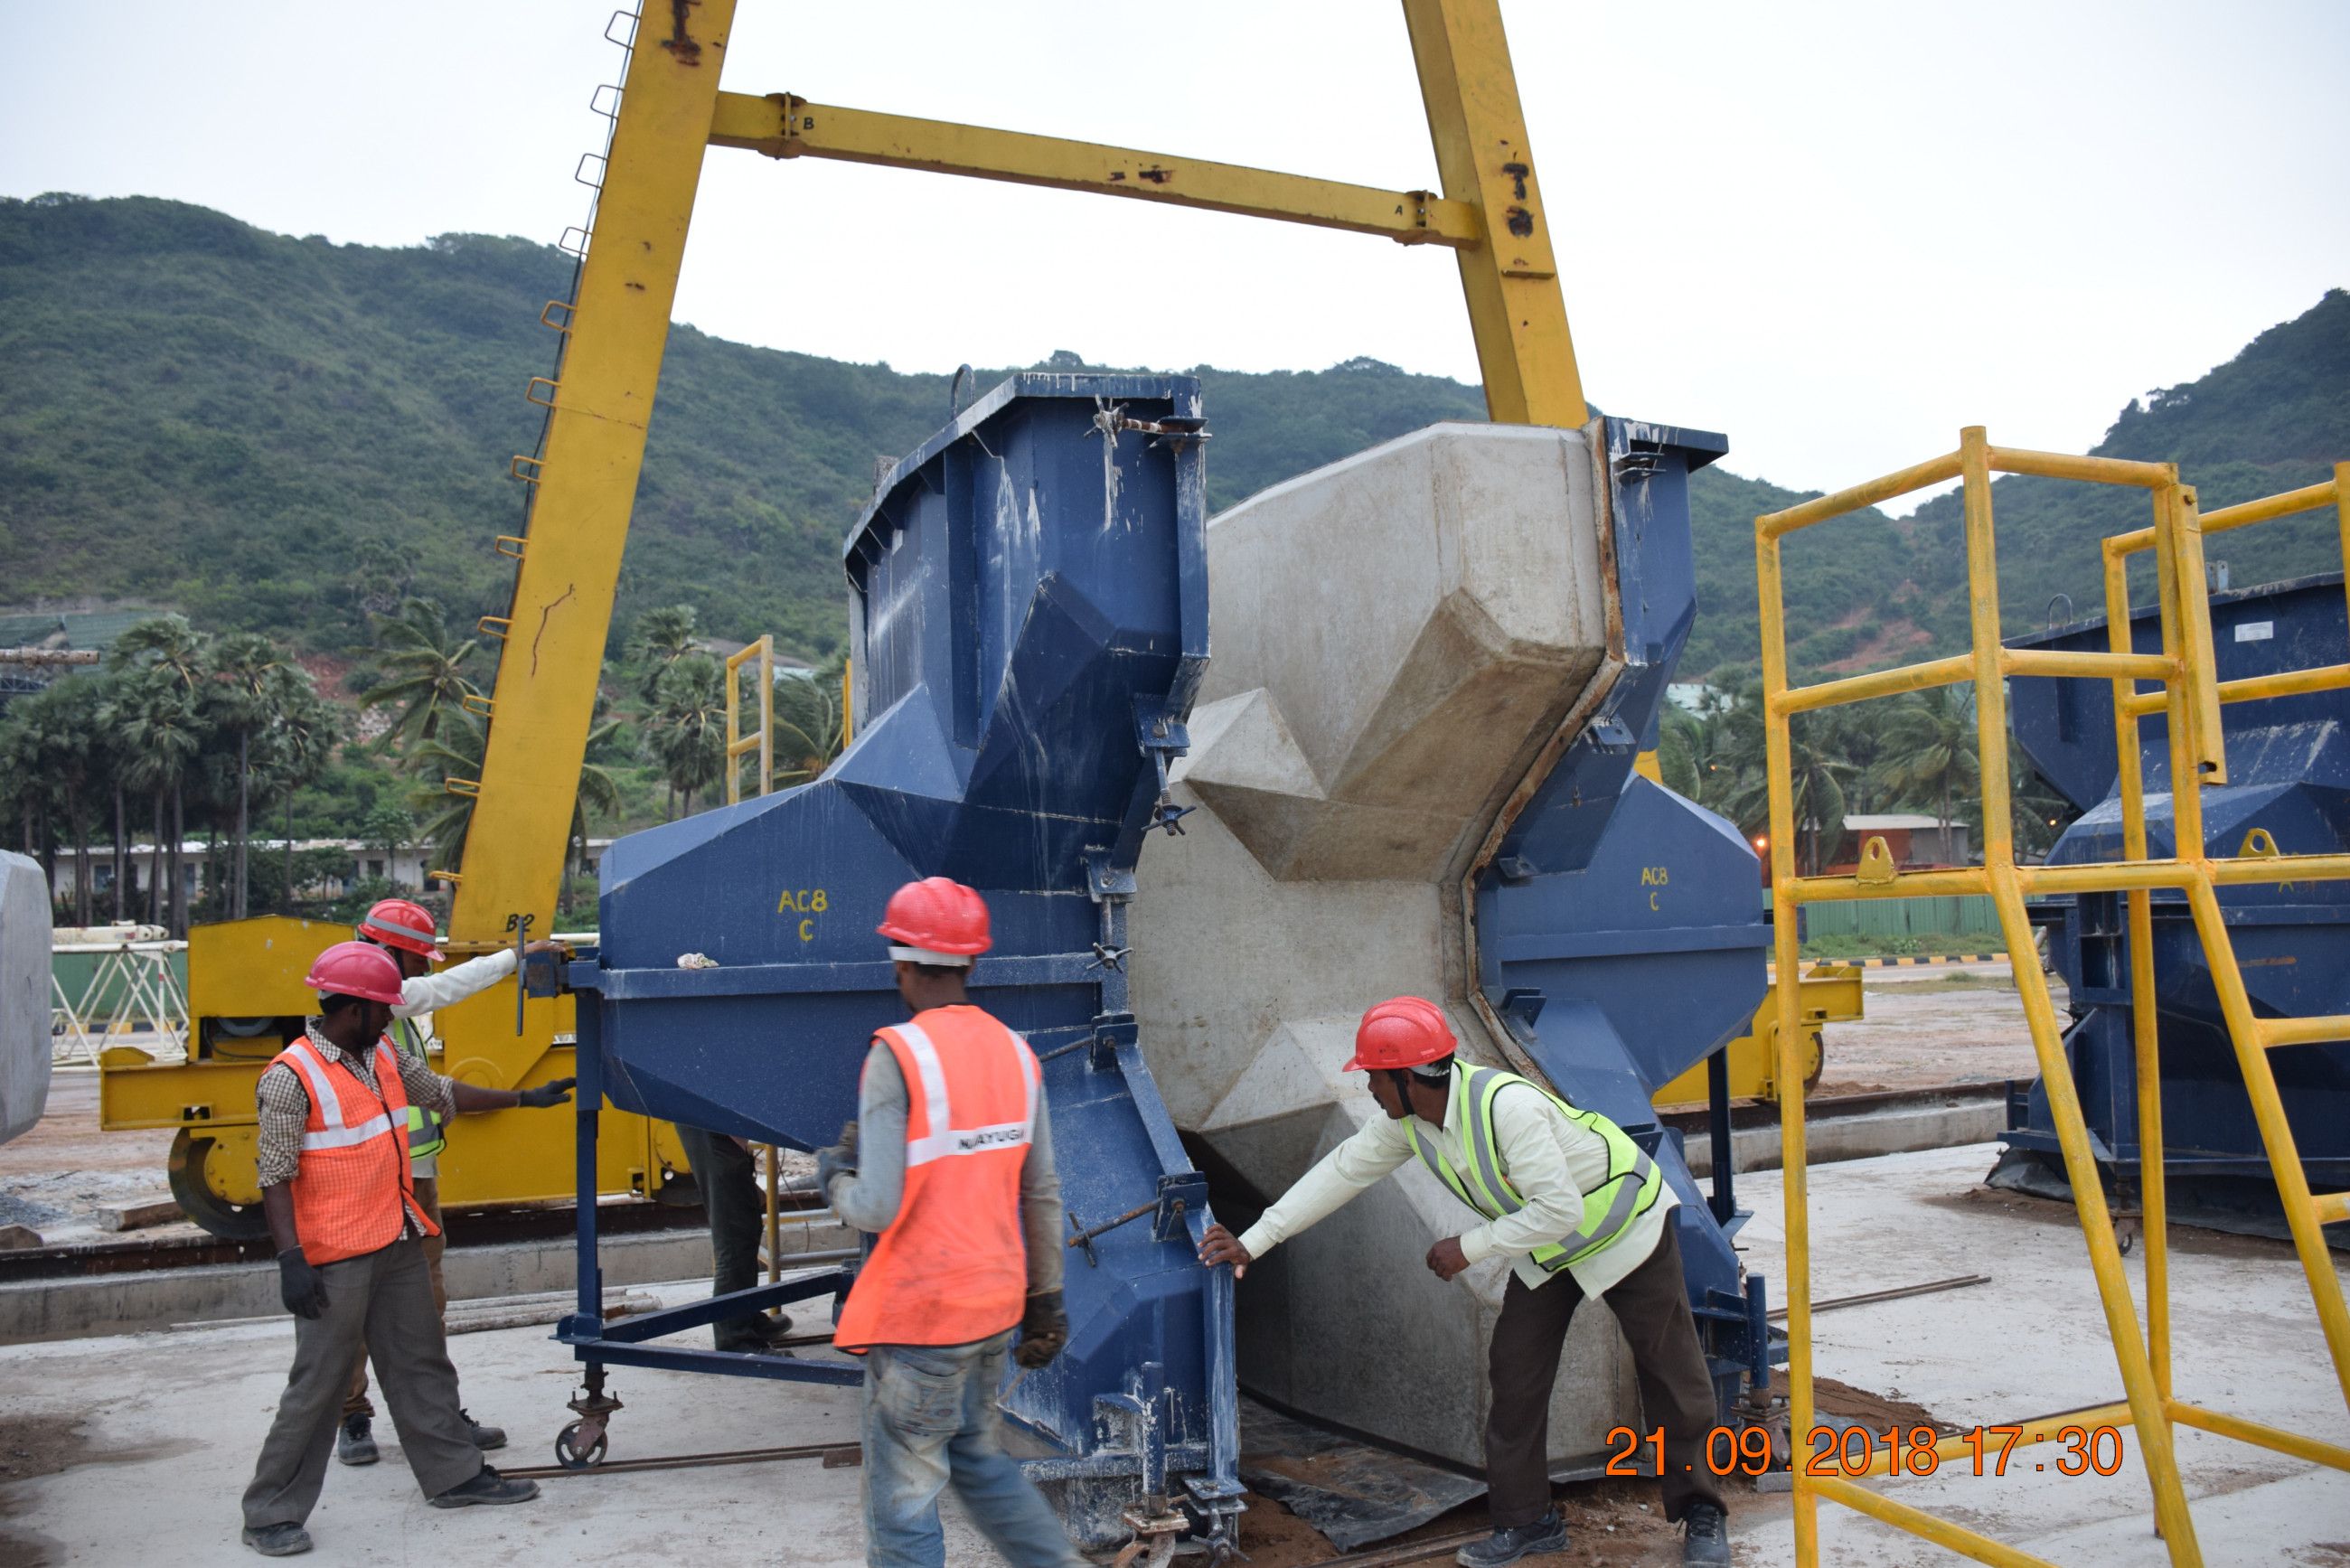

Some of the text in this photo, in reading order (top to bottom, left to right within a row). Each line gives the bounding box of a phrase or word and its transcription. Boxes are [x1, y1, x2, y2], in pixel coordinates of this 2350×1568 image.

[804, 117, 814, 130] B
[1395, 204, 1403, 217] A
[777, 889, 828, 913] AC8
[1650, 892, 1659, 911] C
[506, 913, 535, 932] B2
[799, 919, 813, 941] C
